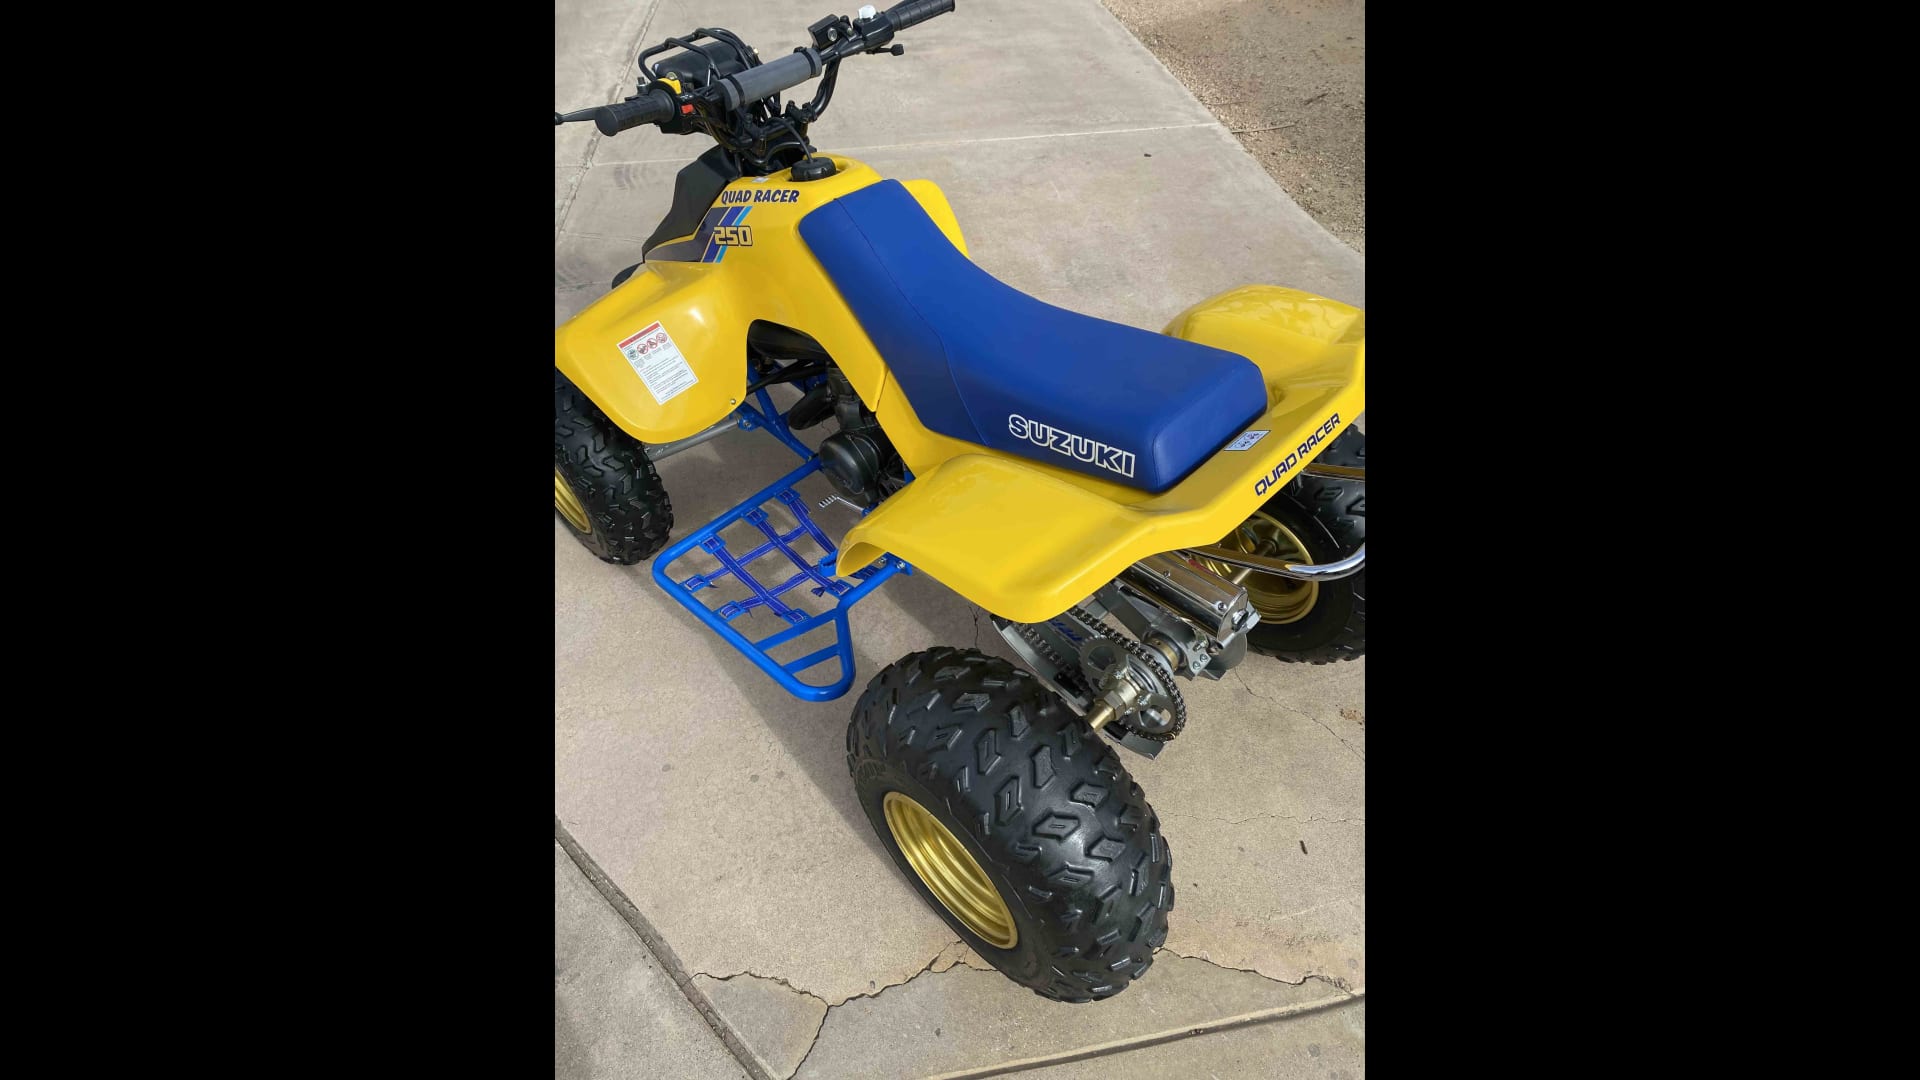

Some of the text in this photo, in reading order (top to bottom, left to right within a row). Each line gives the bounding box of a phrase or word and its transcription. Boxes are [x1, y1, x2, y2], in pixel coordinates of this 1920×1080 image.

[721, 189, 800, 205] QUAD RACER
[714, 225, 753, 247] 250
[1008, 413, 1136, 478] SUZUKI
[1254, 452, 1298, 497] QUAD
[1296, 412, 1341, 459] RACER
